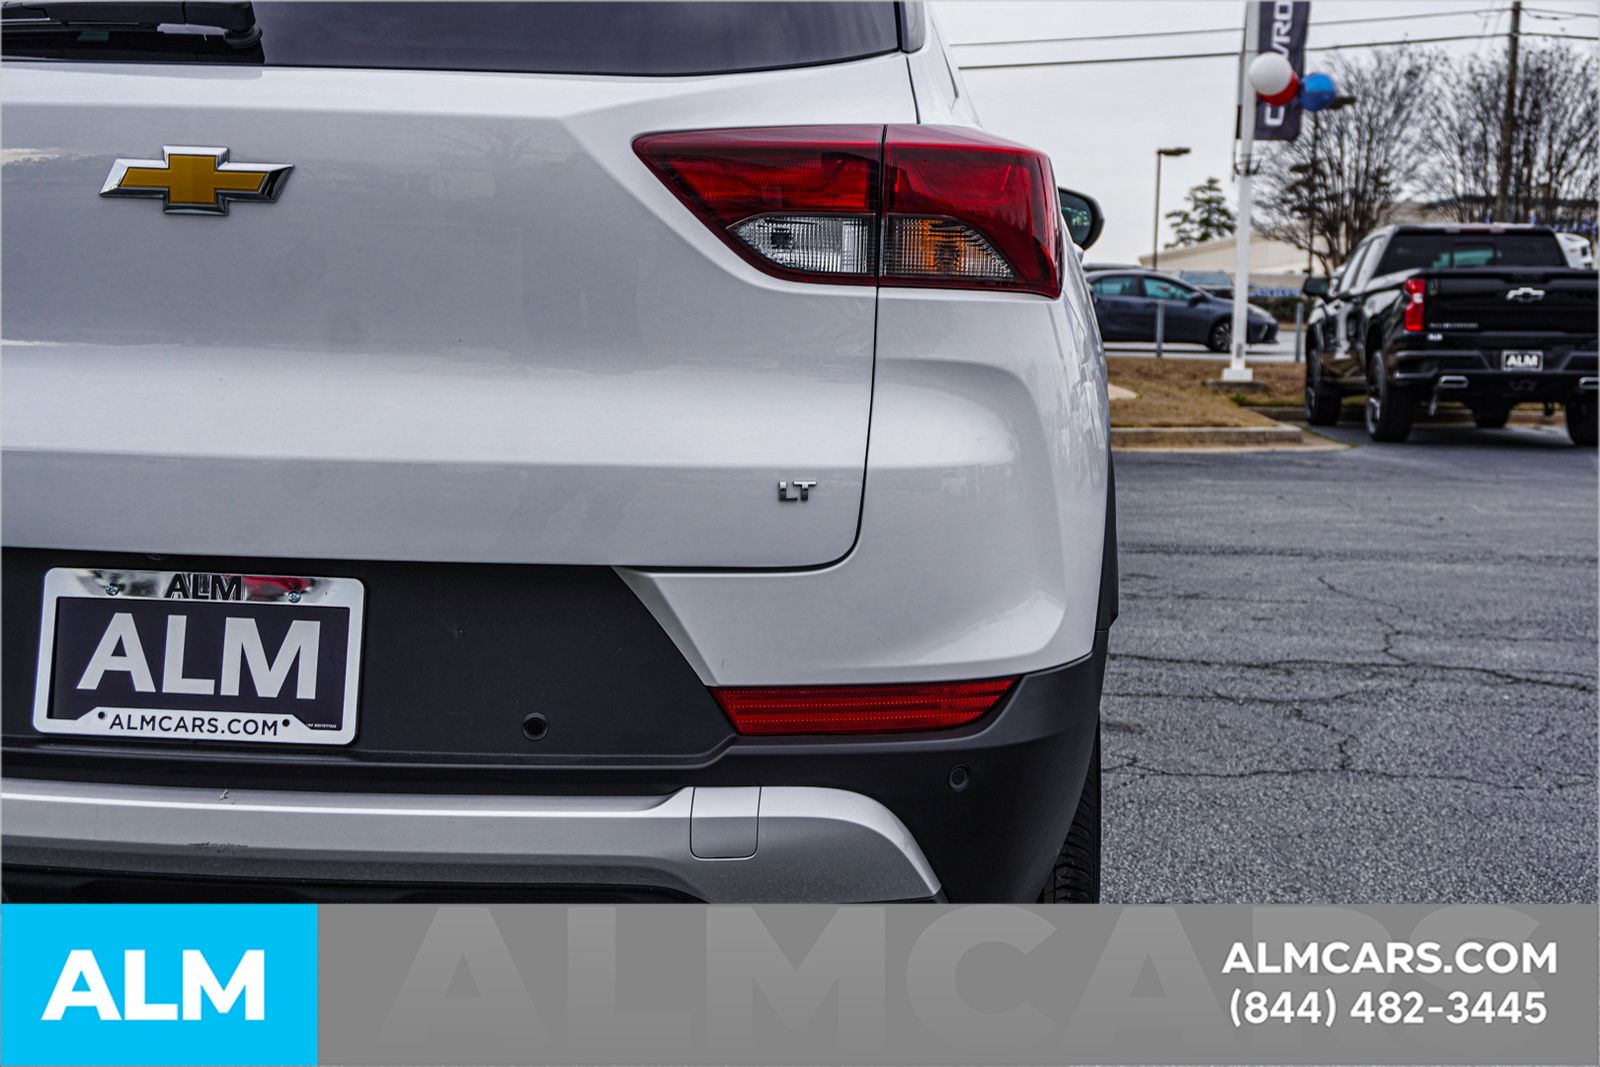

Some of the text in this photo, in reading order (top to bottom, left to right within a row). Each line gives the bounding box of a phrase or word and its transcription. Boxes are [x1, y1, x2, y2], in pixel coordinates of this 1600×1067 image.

[1506, 355, 1538, 368] ALM
[779, 481, 817, 502] LT
[164, 573, 242, 600] ALM
[76, 612, 321, 700] ALM
[109, 714, 278, 736] ALMCARS.COM
